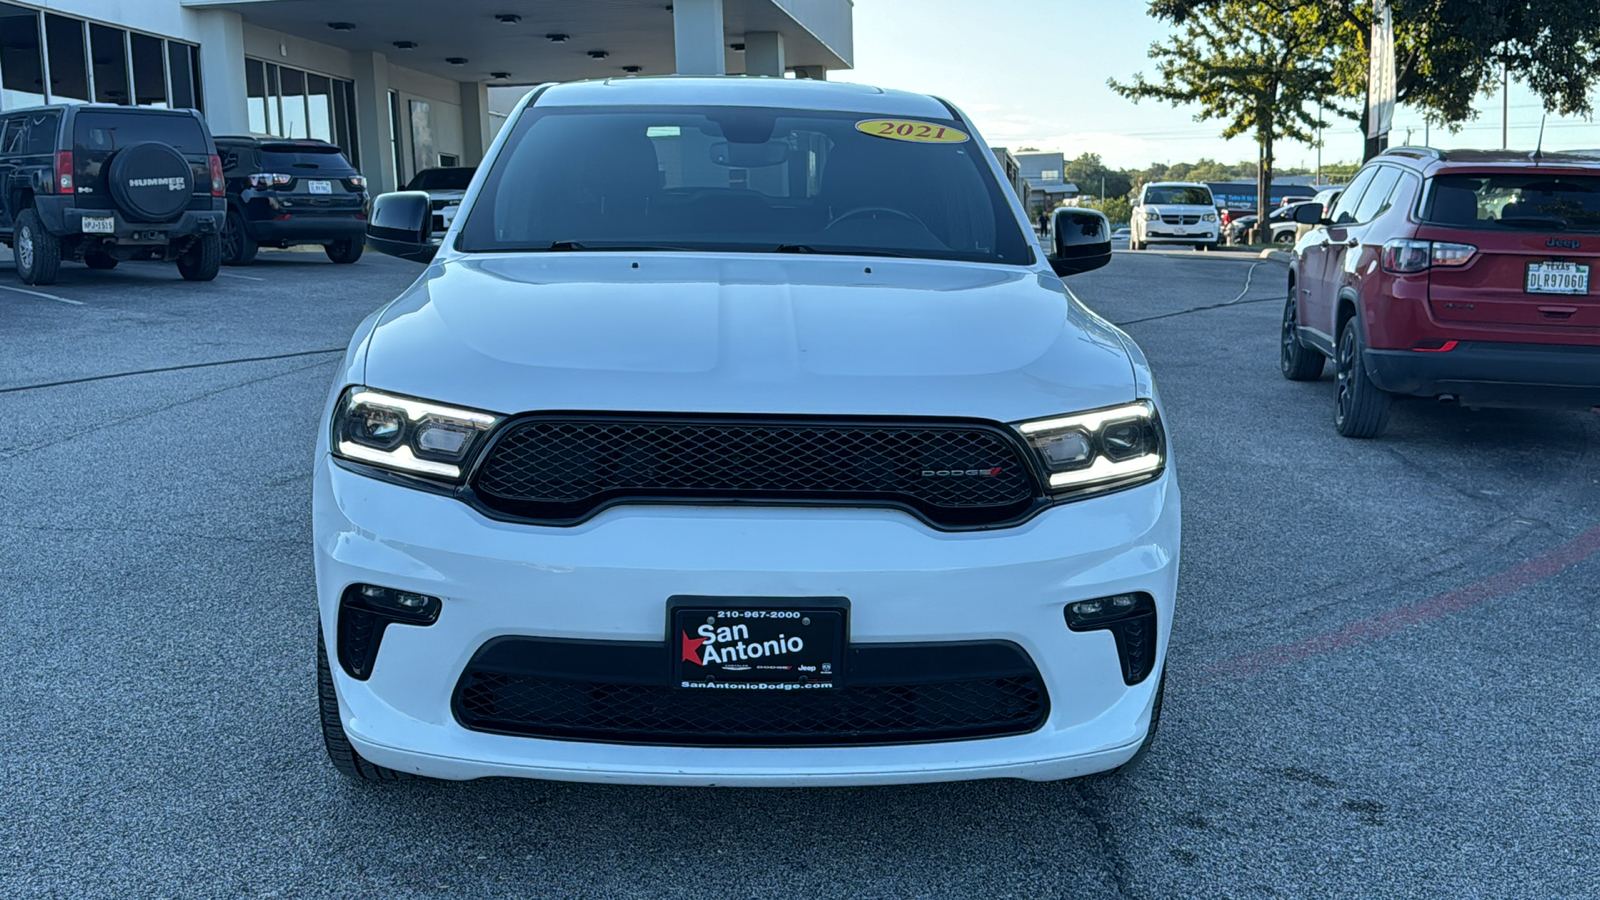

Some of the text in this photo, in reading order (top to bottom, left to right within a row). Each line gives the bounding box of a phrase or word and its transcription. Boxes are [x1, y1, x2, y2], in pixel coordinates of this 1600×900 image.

[878, 122, 946, 139] 2021
[129, 177, 184, 187] HUMMER
[1546, 237, 1580, 249] Jeep
[1546, 263, 1571, 271] TEXAS
[1530, 273, 1585, 289] DLR97060
[921, 468, 993, 477] DODGE
[717, 611, 801, 619] 210-967-2000
[697, 623, 749, 645] San
[702, 633, 804, 666] Antonio
[798, 664, 816, 672] Jeep
[681, 681, 833, 691] SanAntonioDodge.com
